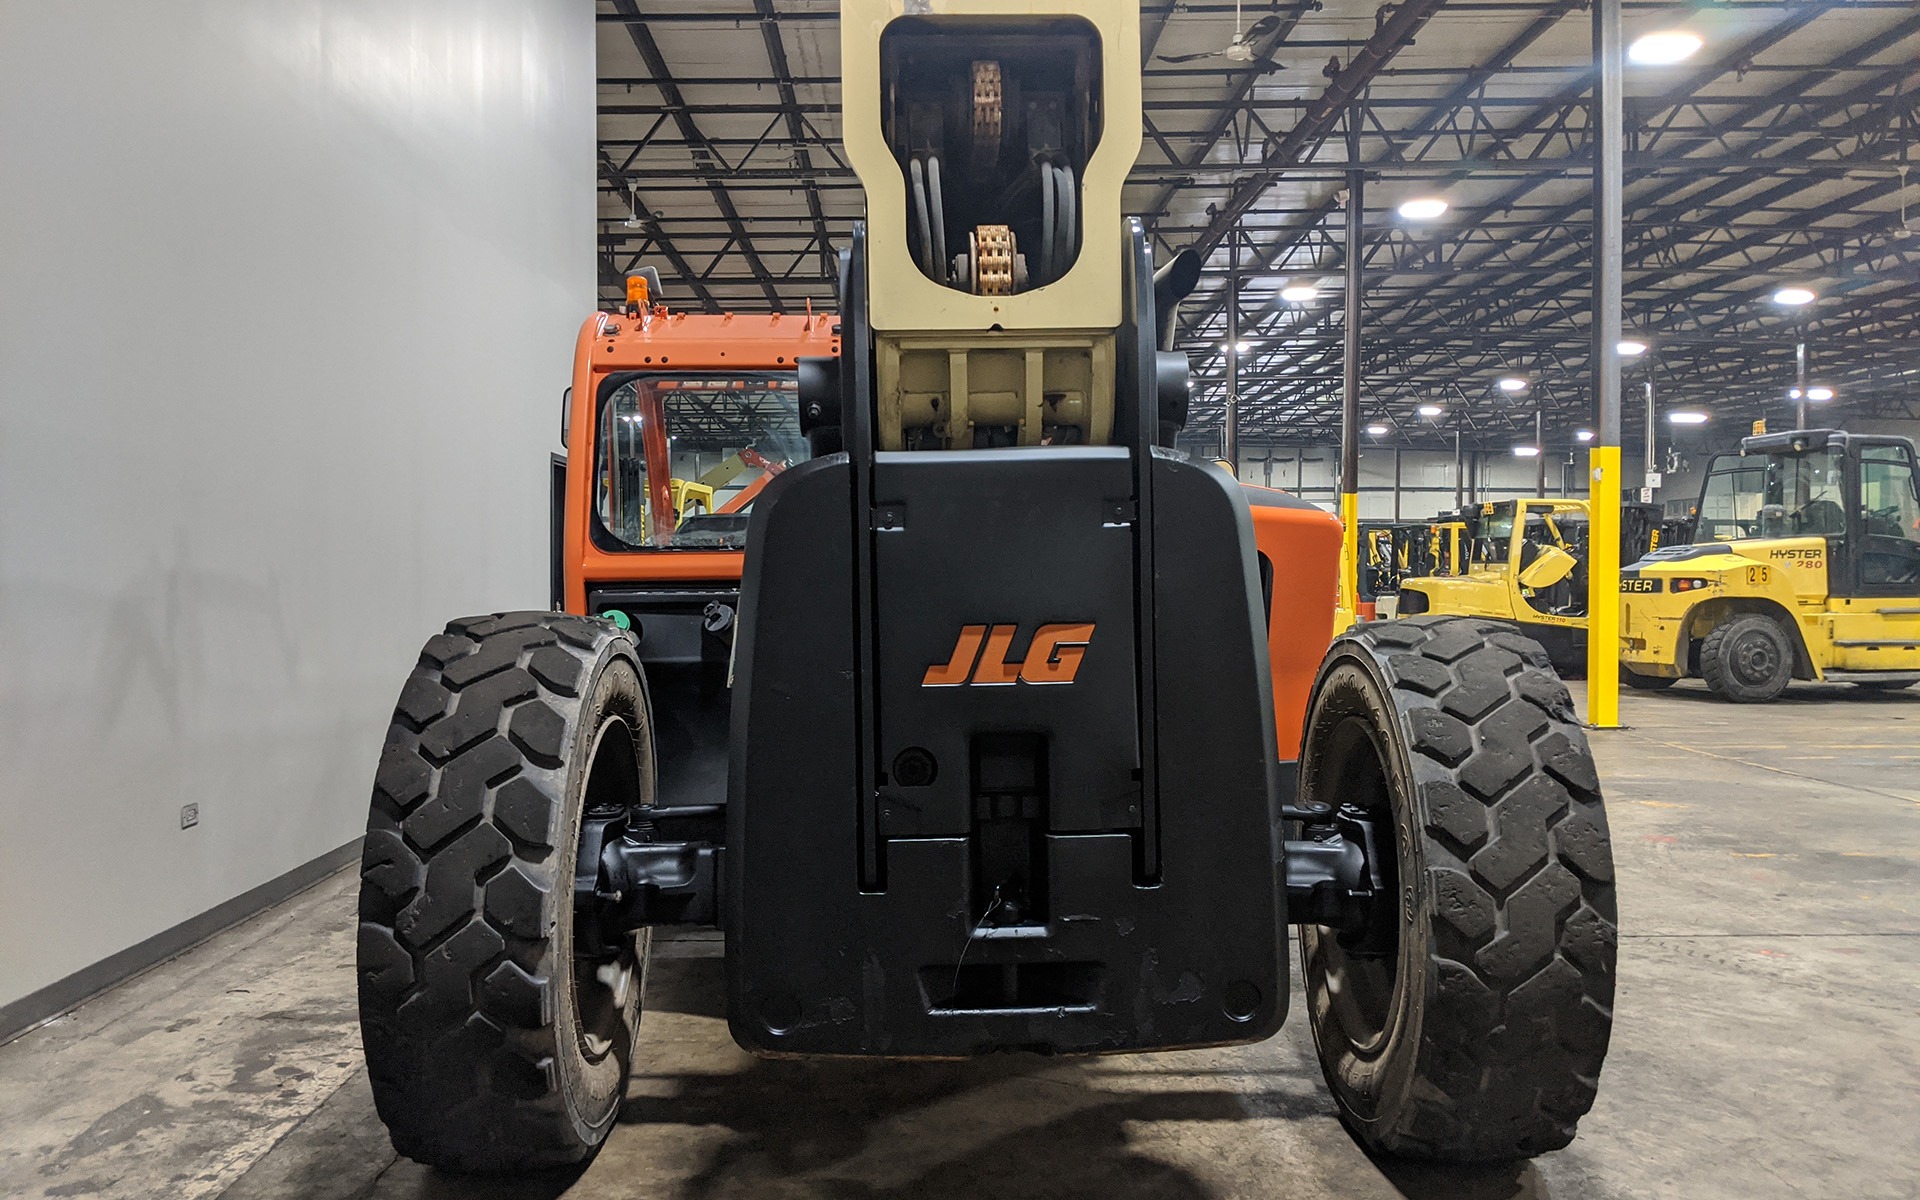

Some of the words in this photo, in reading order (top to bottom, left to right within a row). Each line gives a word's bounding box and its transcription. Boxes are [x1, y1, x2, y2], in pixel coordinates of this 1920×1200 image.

[1649, 529, 1660, 552] STER
[1770, 549, 1822, 559] HYSTER
[1619, 580, 1653, 591] STER
[921, 623, 1096, 687] JLG
